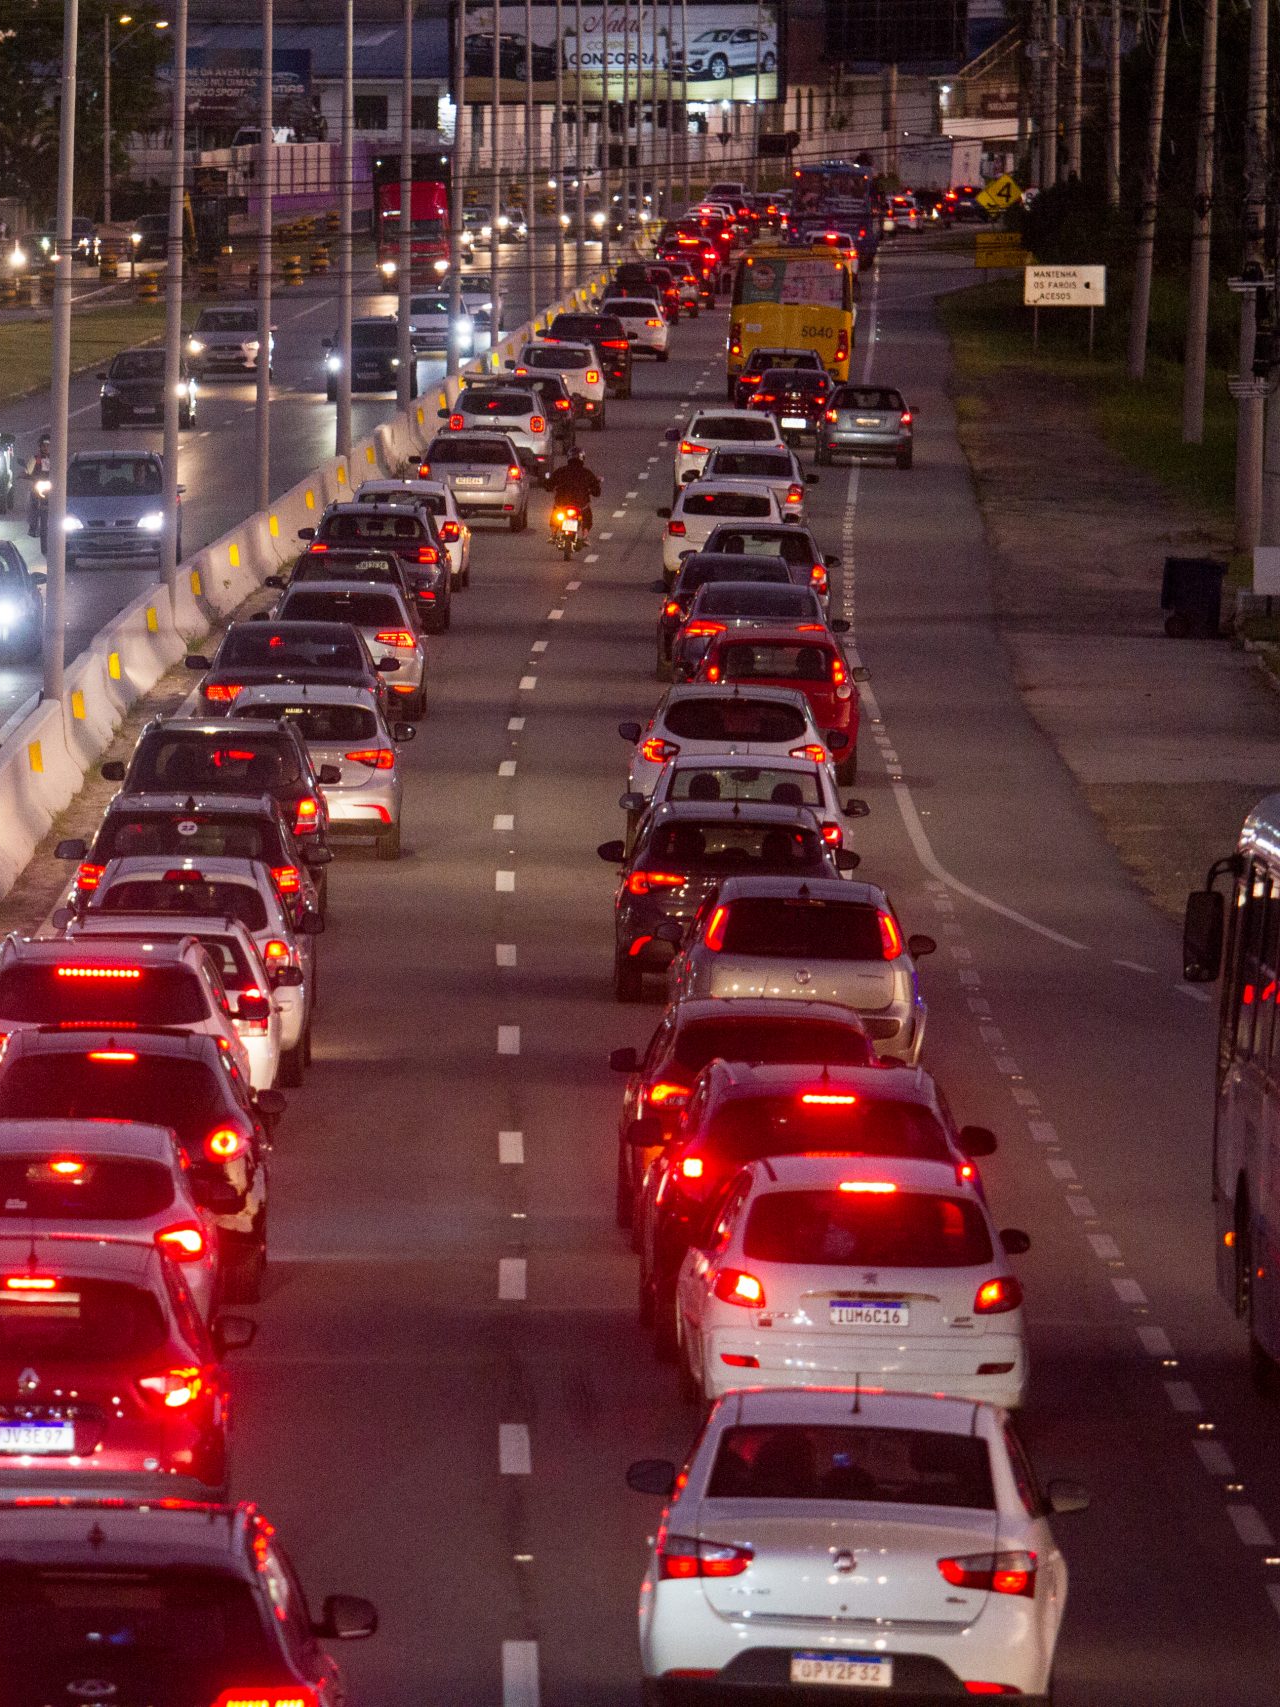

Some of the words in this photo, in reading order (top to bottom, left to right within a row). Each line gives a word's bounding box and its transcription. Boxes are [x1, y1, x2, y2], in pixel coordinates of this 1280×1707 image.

[569, 53, 659, 65] CONCORRA
[1033, 281, 1045, 289] OS
[802, 326, 834, 339] 5040
[837, 1308, 902, 1325] IUM6C16
